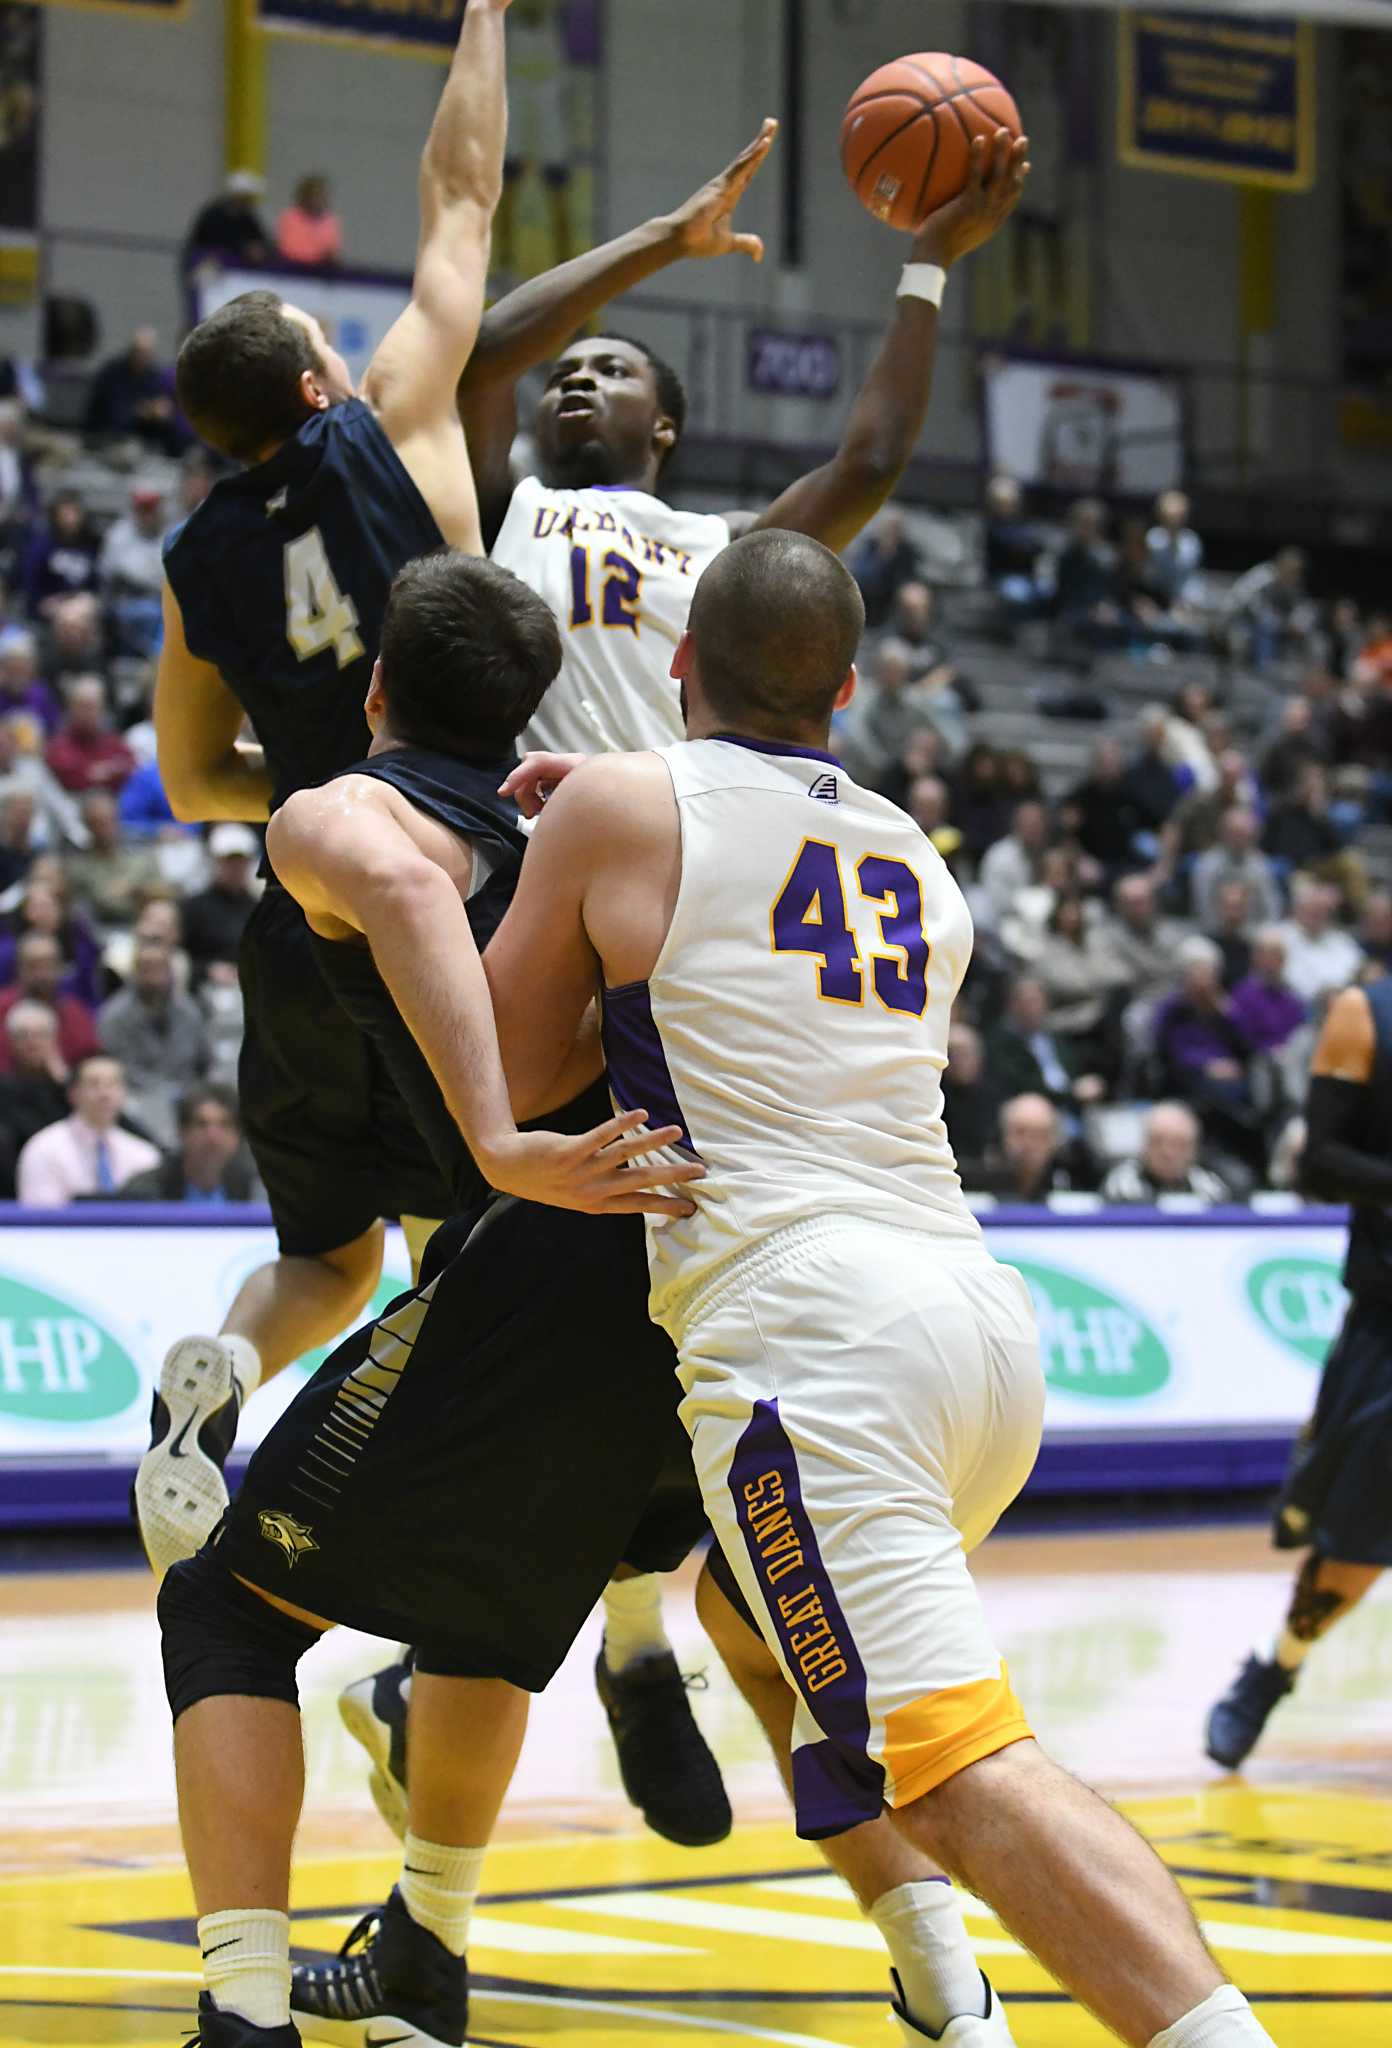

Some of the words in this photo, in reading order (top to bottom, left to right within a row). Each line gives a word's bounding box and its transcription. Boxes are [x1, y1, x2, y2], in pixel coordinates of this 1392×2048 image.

[283, 524, 366, 671] 4
[569, 544, 640, 639] 12
[769, 836, 931, 1020] 43
[744, 1470, 804, 1585] DANES
[777, 1583, 848, 1693] GREAT
